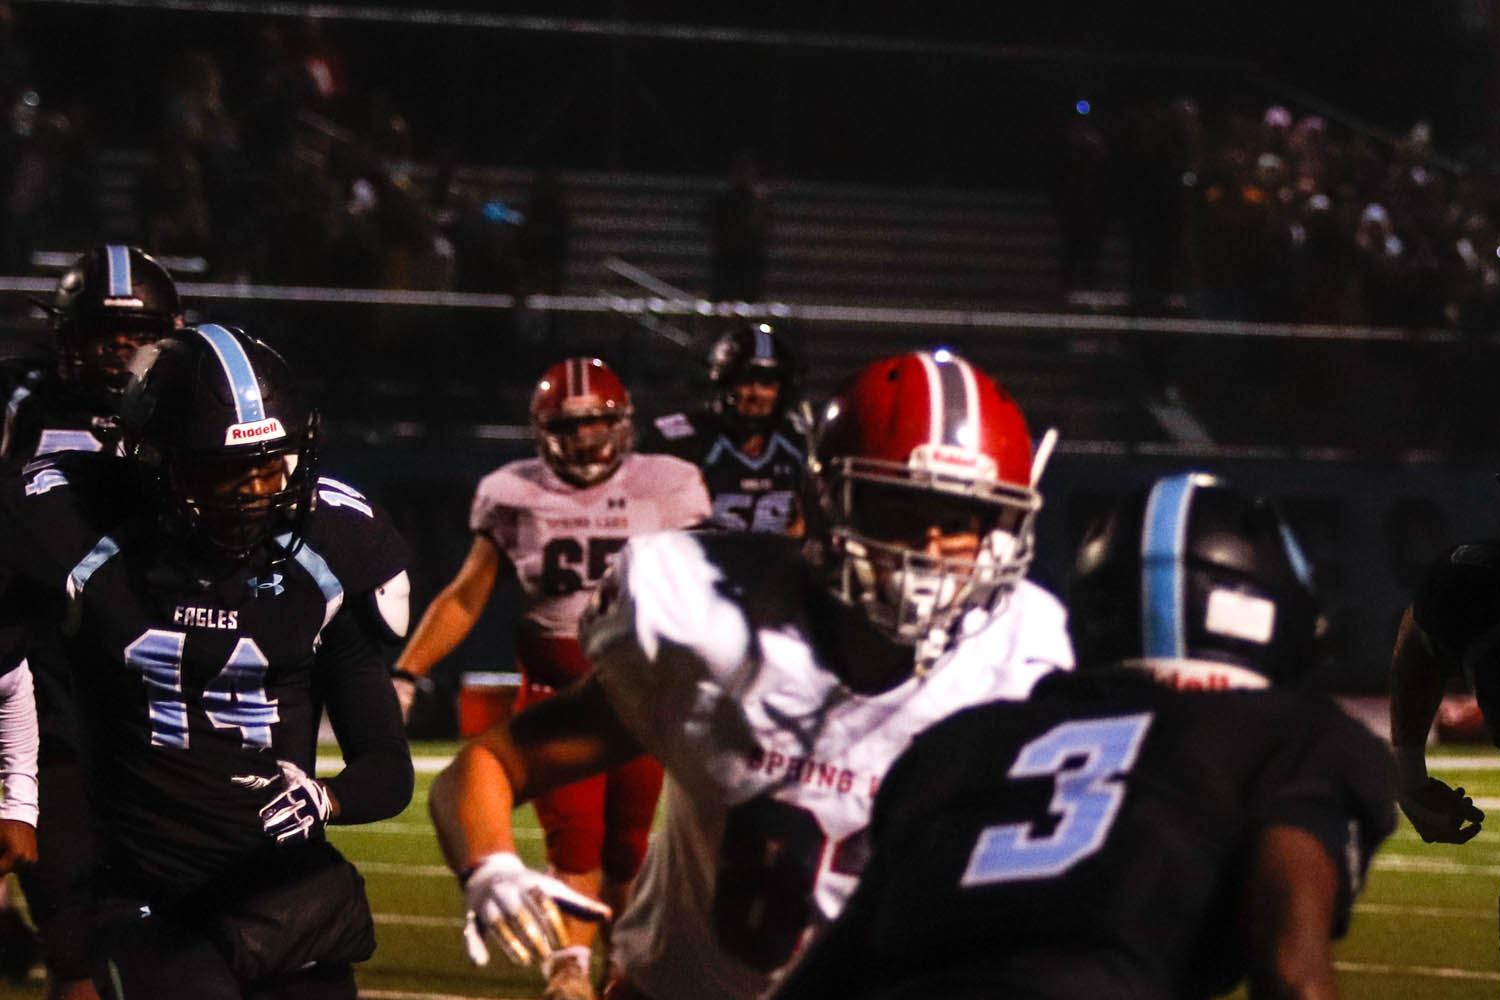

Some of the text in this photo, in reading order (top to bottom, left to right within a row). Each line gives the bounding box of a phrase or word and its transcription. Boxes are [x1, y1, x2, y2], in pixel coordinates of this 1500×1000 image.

[232, 422, 278, 440] Riddell
[173, 605, 239, 630] EAGLES
[123, 628, 281, 750] 14
[959, 711, 1157, 889] 3
